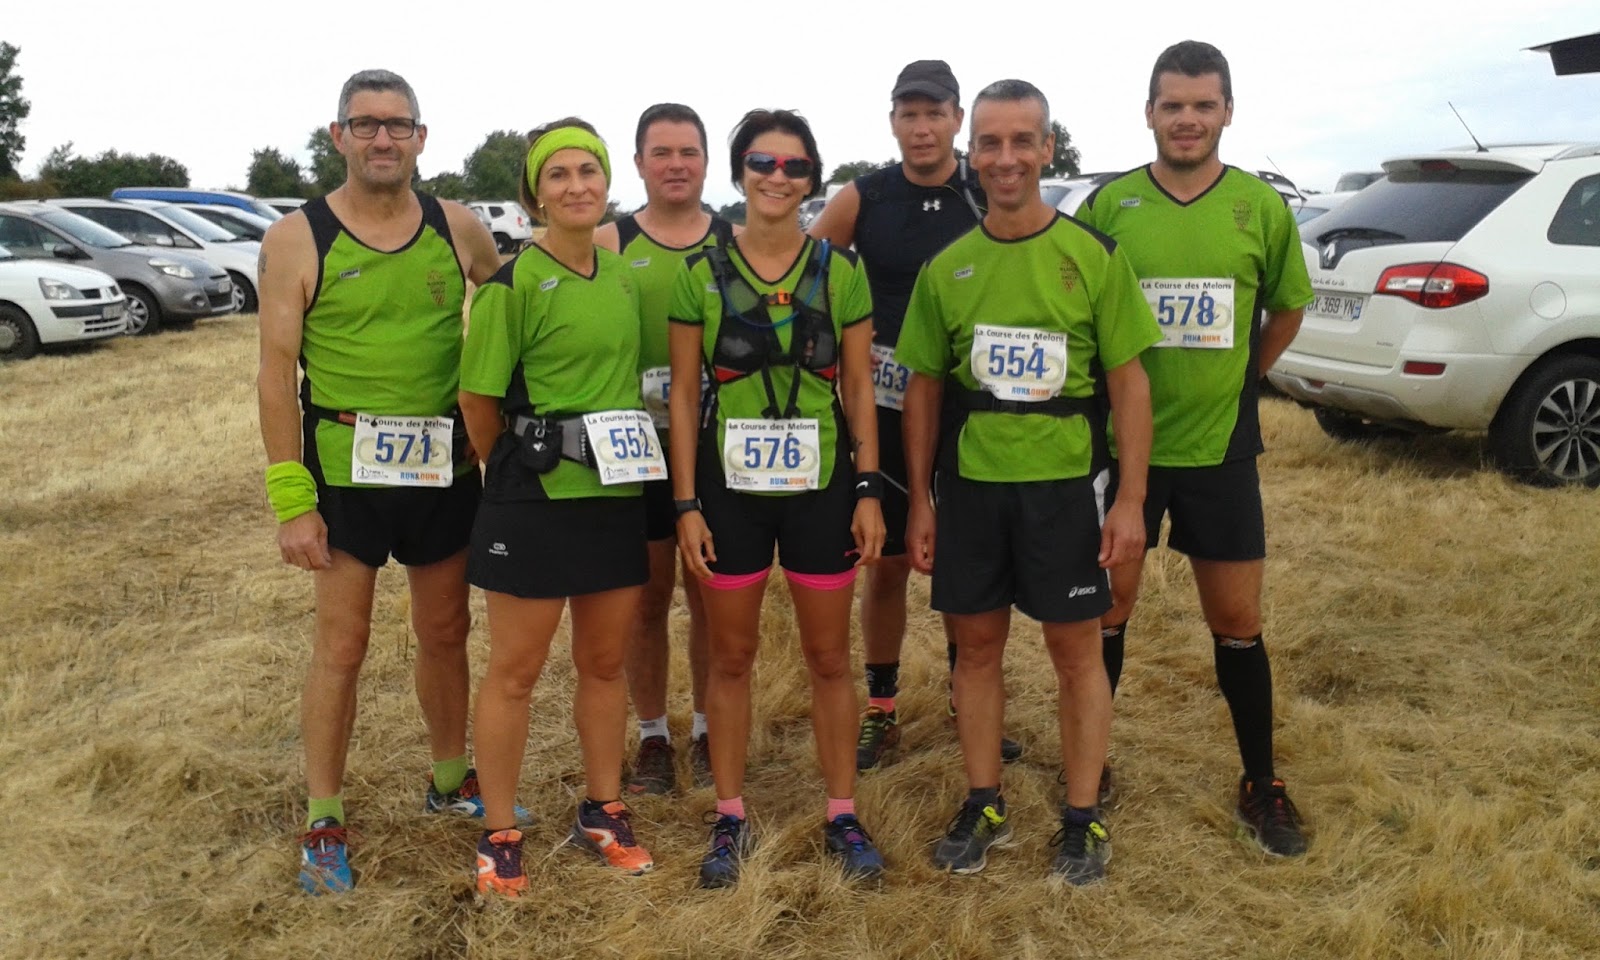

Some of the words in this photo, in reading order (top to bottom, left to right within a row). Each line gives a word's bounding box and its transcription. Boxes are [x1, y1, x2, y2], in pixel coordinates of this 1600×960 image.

[1141, 281, 1152, 290] La
[1154, 281, 1182, 290] Course
[1184, 281, 1199, 290] des
[1202, 281, 1232, 290] Melons
[1157, 295, 1215, 328] 578
[975, 328, 984, 336] La
[986, 329, 1012, 339] Course
[1015, 331, 1030, 340] des
[1033, 332, 1065, 343] Melons
[987, 344, 1045, 380] 554
[359, 415, 370, 423] La
[406, 420, 421, 428] des
[423, 420, 451, 430] Melons
[587, 416, 598, 425] La
[728, 422, 739, 430] La
[740, 422, 767, 431] Course
[769, 422, 785, 431] des
[787, 422, 817, 431] Melons
[375, 431, 432, 465] 571
[608, 426, 654, 460] 552
[743, 436, 801, 469] 576
